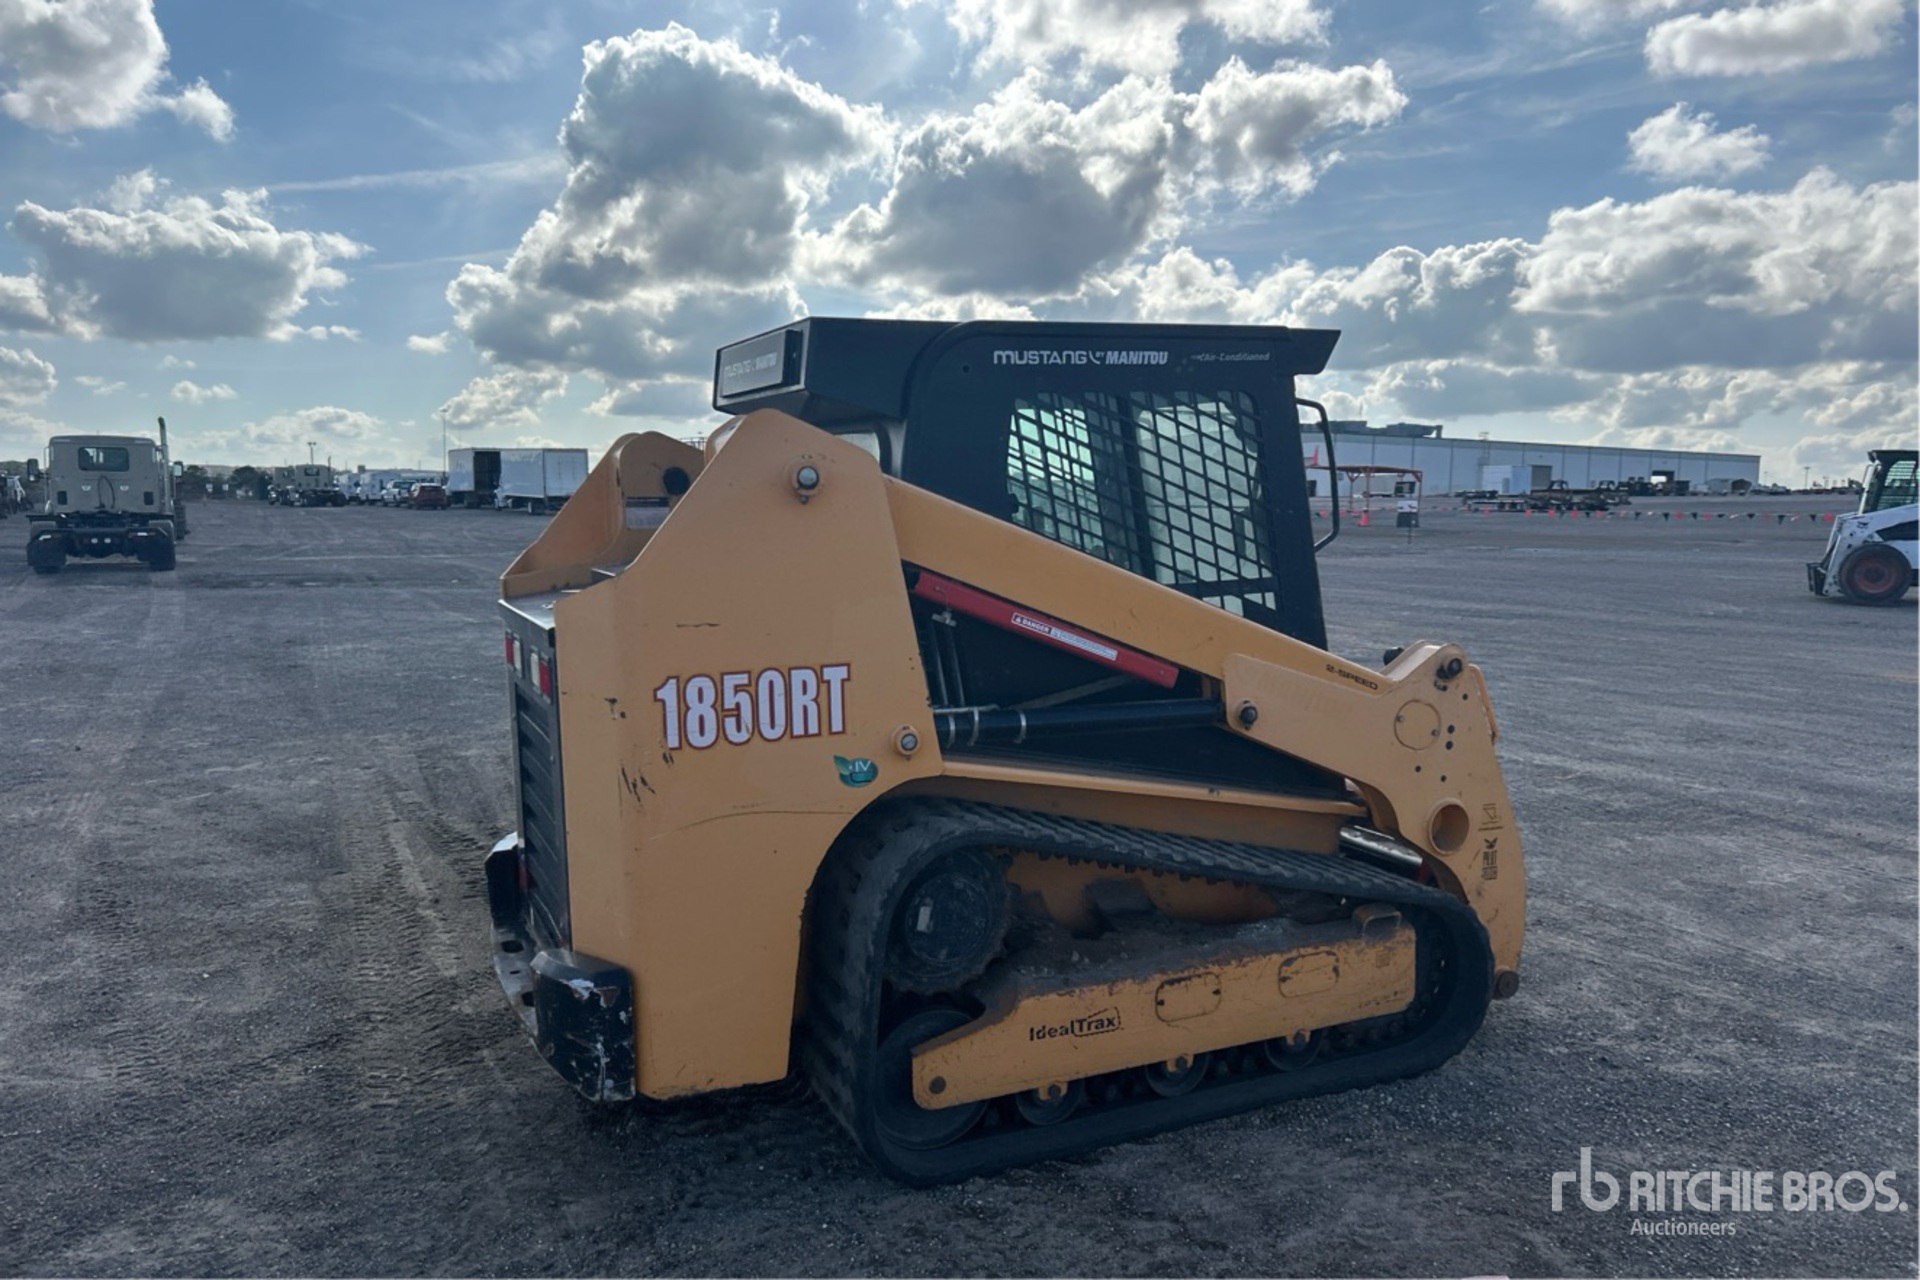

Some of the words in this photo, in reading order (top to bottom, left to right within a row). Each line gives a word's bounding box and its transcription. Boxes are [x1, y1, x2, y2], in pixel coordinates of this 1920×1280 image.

[993, 350, 1088, 365] MUSTANG
[1105, 350, 1168, 365] MANITOU
[1022, 618, 1051, 633] DANGER
[1325, 663, 1379, 691] 2-SPEED
[653, 662, 851, 751] 1850RT
[1029, 1017, 1117, 1042] IdealTrax
